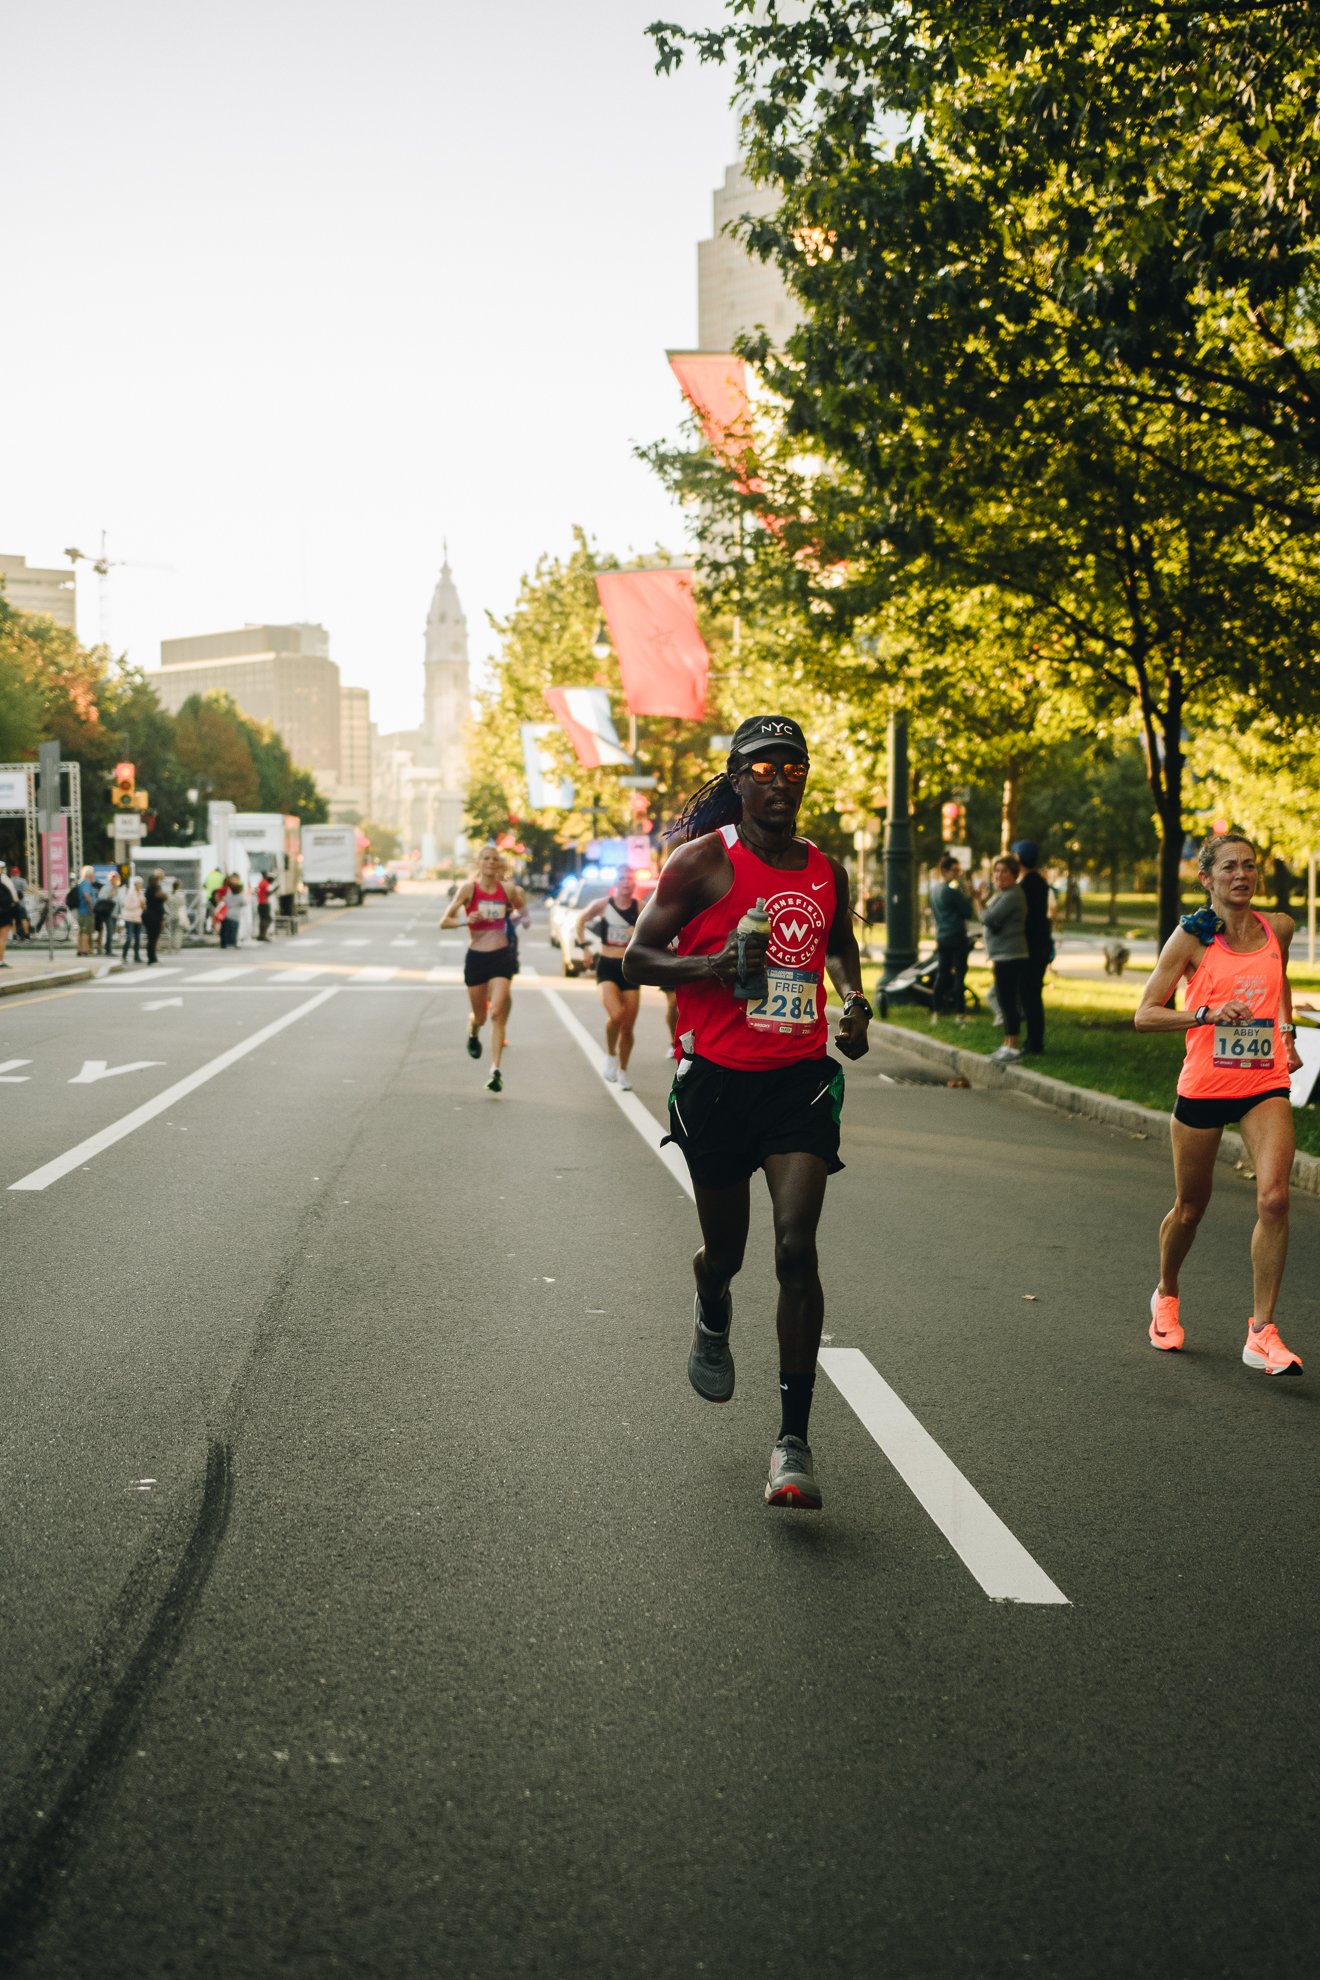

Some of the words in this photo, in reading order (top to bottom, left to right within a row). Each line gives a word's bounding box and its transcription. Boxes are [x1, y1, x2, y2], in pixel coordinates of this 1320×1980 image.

[761, 721, 793, 735] NYC
[768, 898, 822, 927] YNNEFIELD
[779, 919, 809, 942] W
[768, 940, 796, 963] RACK
[800, 937, 819, 961] CLUB
[775, 982, 804, 993] FRED
[752, 995, 815, 1019] 2284
[1219, 1038, 1271, 1056] 1640
